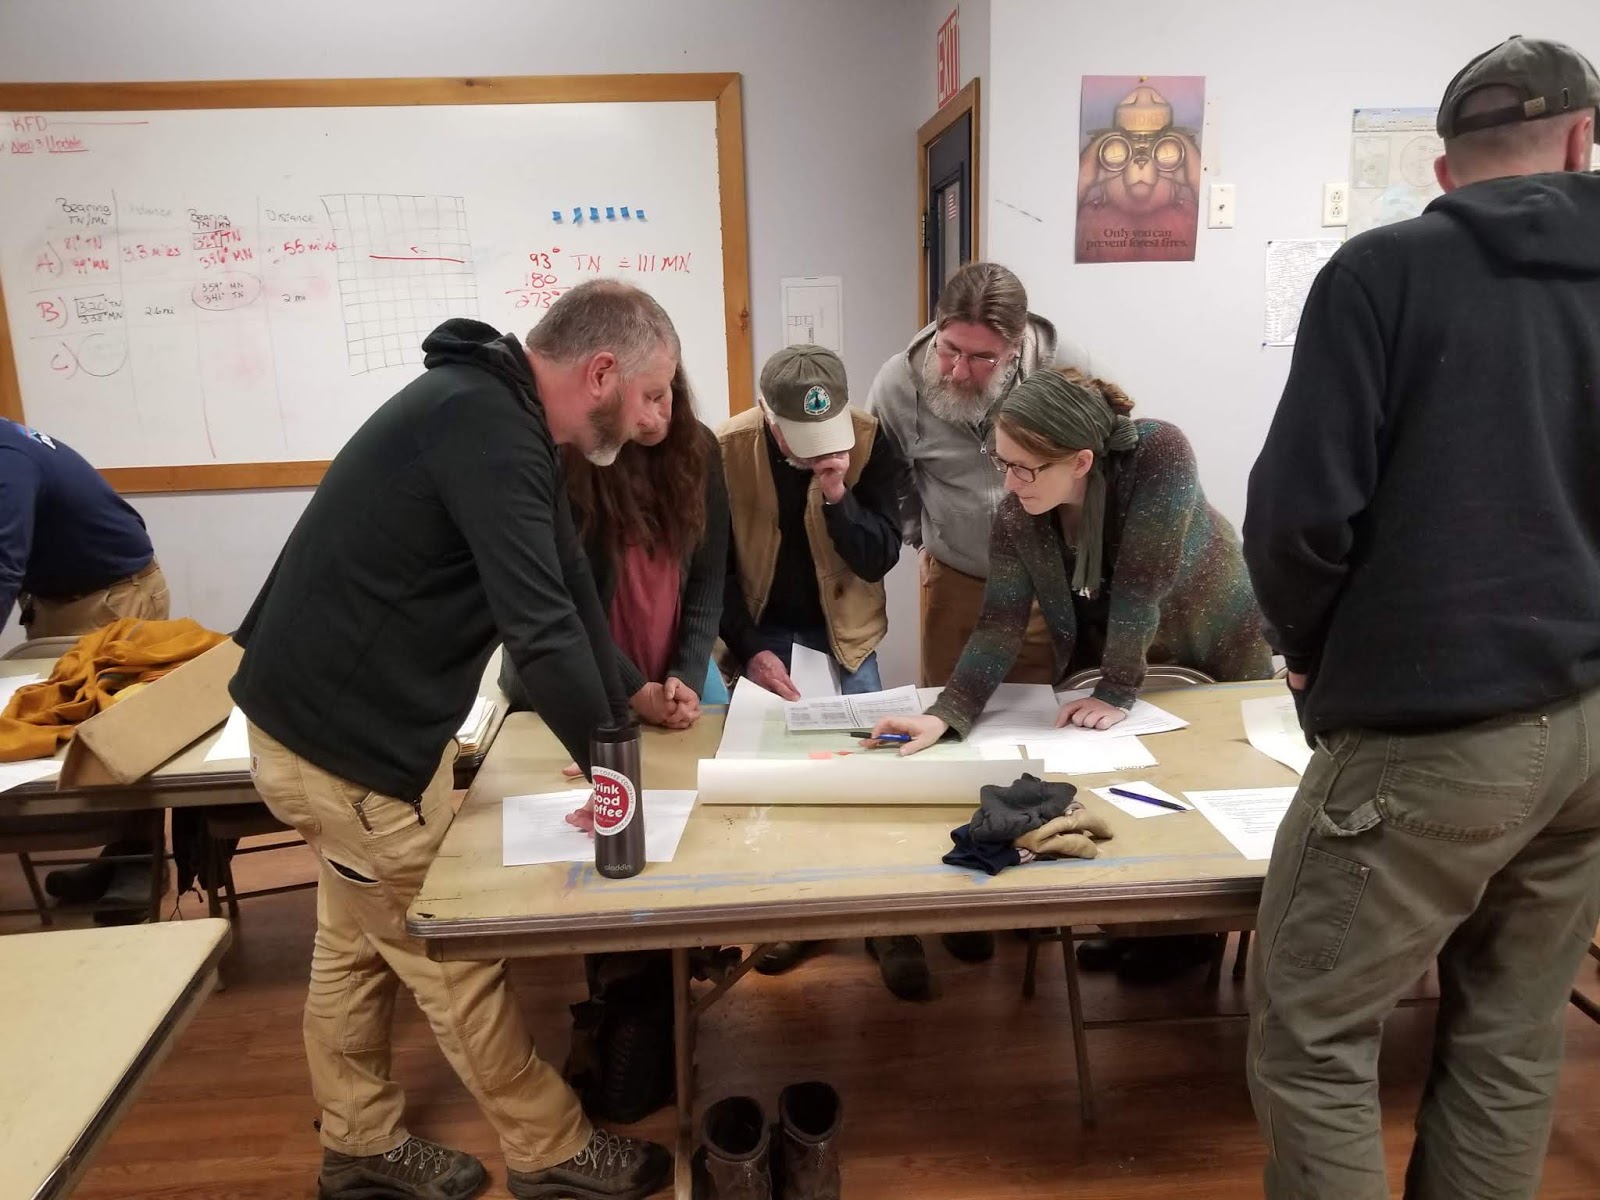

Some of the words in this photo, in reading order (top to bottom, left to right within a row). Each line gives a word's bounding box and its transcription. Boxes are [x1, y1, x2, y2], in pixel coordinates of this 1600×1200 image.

[55, 197, 112, 216] Bearing
[264, 209, 316, 222] Distance
[1103, 228, 1129, 239] Only
[1131, 230, 1152, 239] you
[1153, 230, 1172, 238] can
[1085, 239, 1126, 250] prevent
[1128, 238, 1160, 249] forest
[569, 254, 601, 273] TN
[660, 252, 692, 273] MN
[594, 794, 620, 806] ood
[594, 804, 623, 818] offee
[604, 863, 632, 871] aladdin
